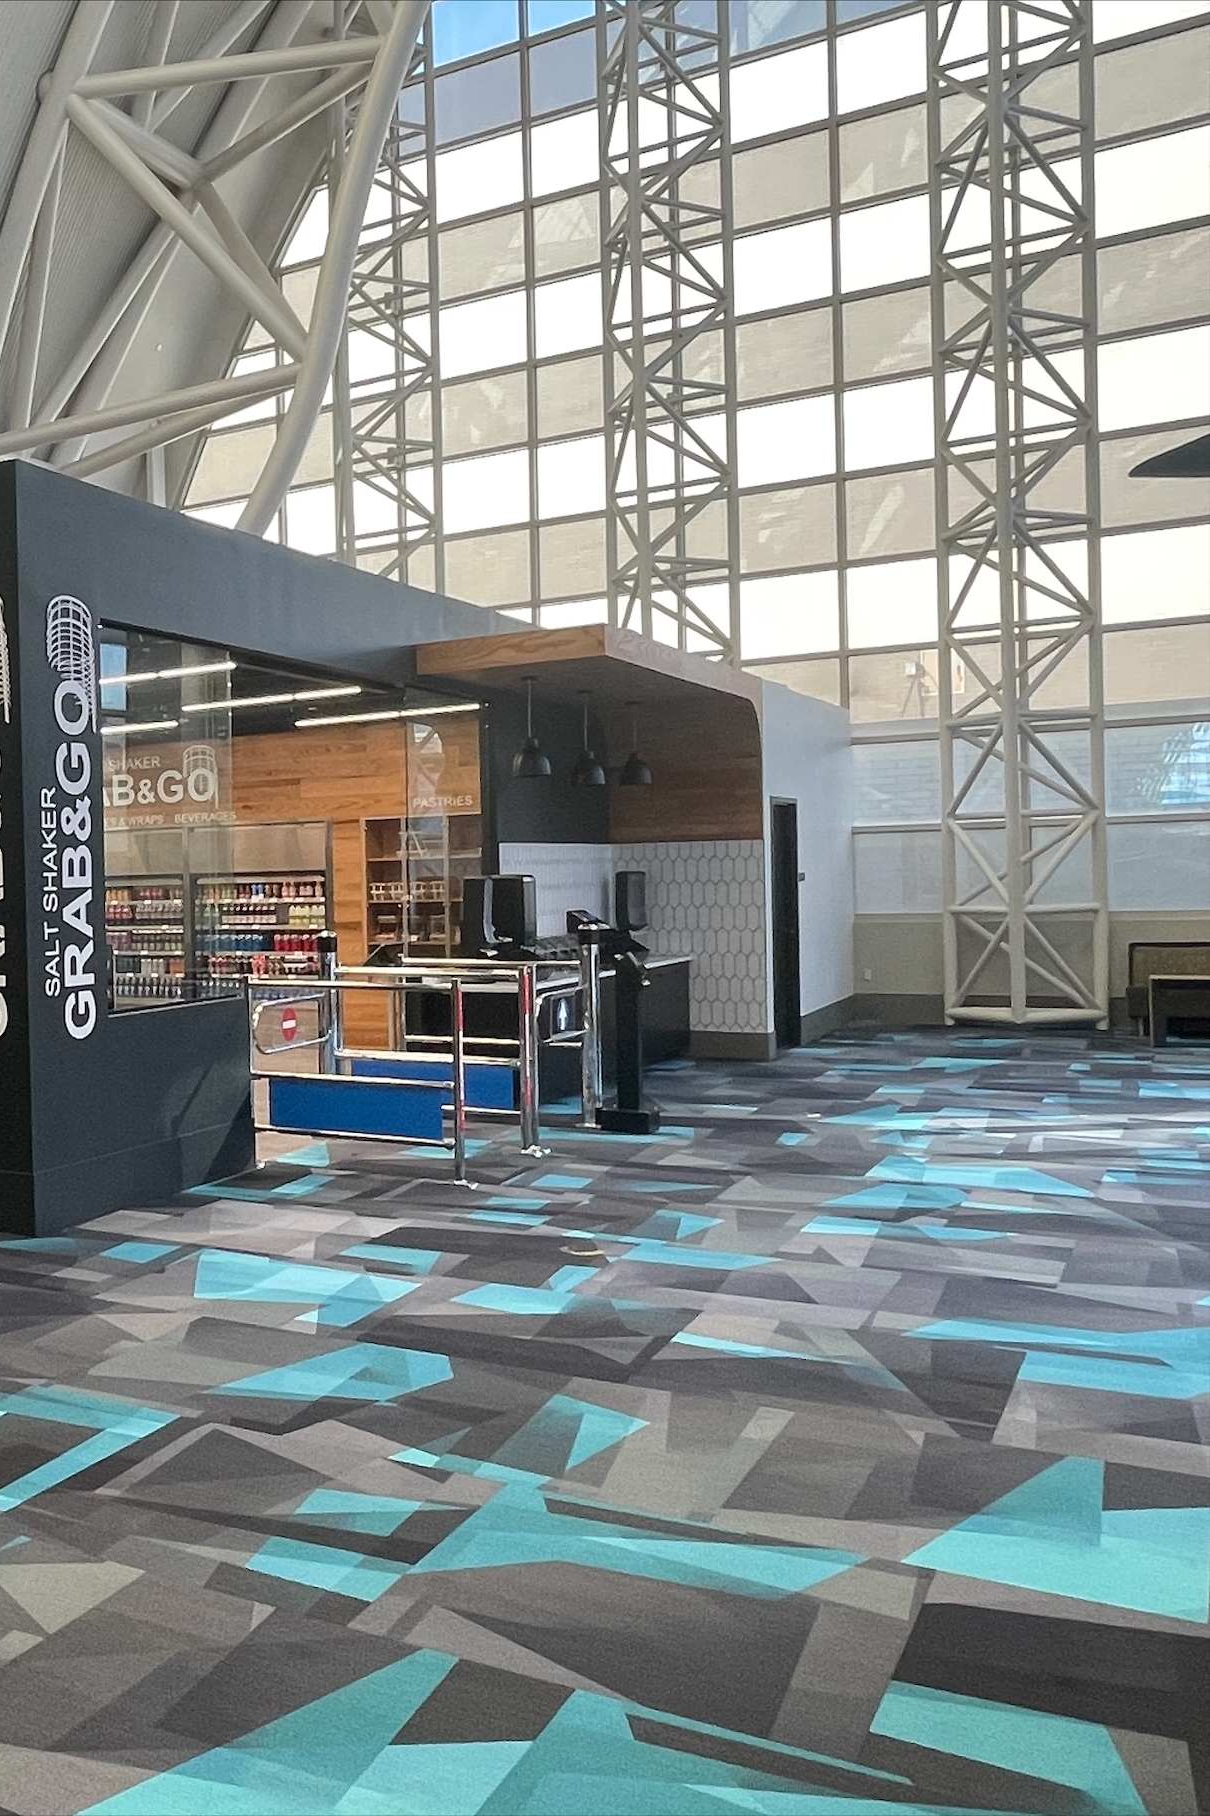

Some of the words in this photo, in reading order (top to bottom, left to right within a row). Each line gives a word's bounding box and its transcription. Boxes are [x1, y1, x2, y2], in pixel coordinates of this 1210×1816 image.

[109, 756, 162, 771] SHAKER
[174, 810, 237, 823] BEVERAGES
[413, 795, 473, 808] PASTRIES
[41, 786, 59, 912] SHAKER
[54, 679, 97, 1040] GRAB&GO
[43, 921, 61, 997] SALT
